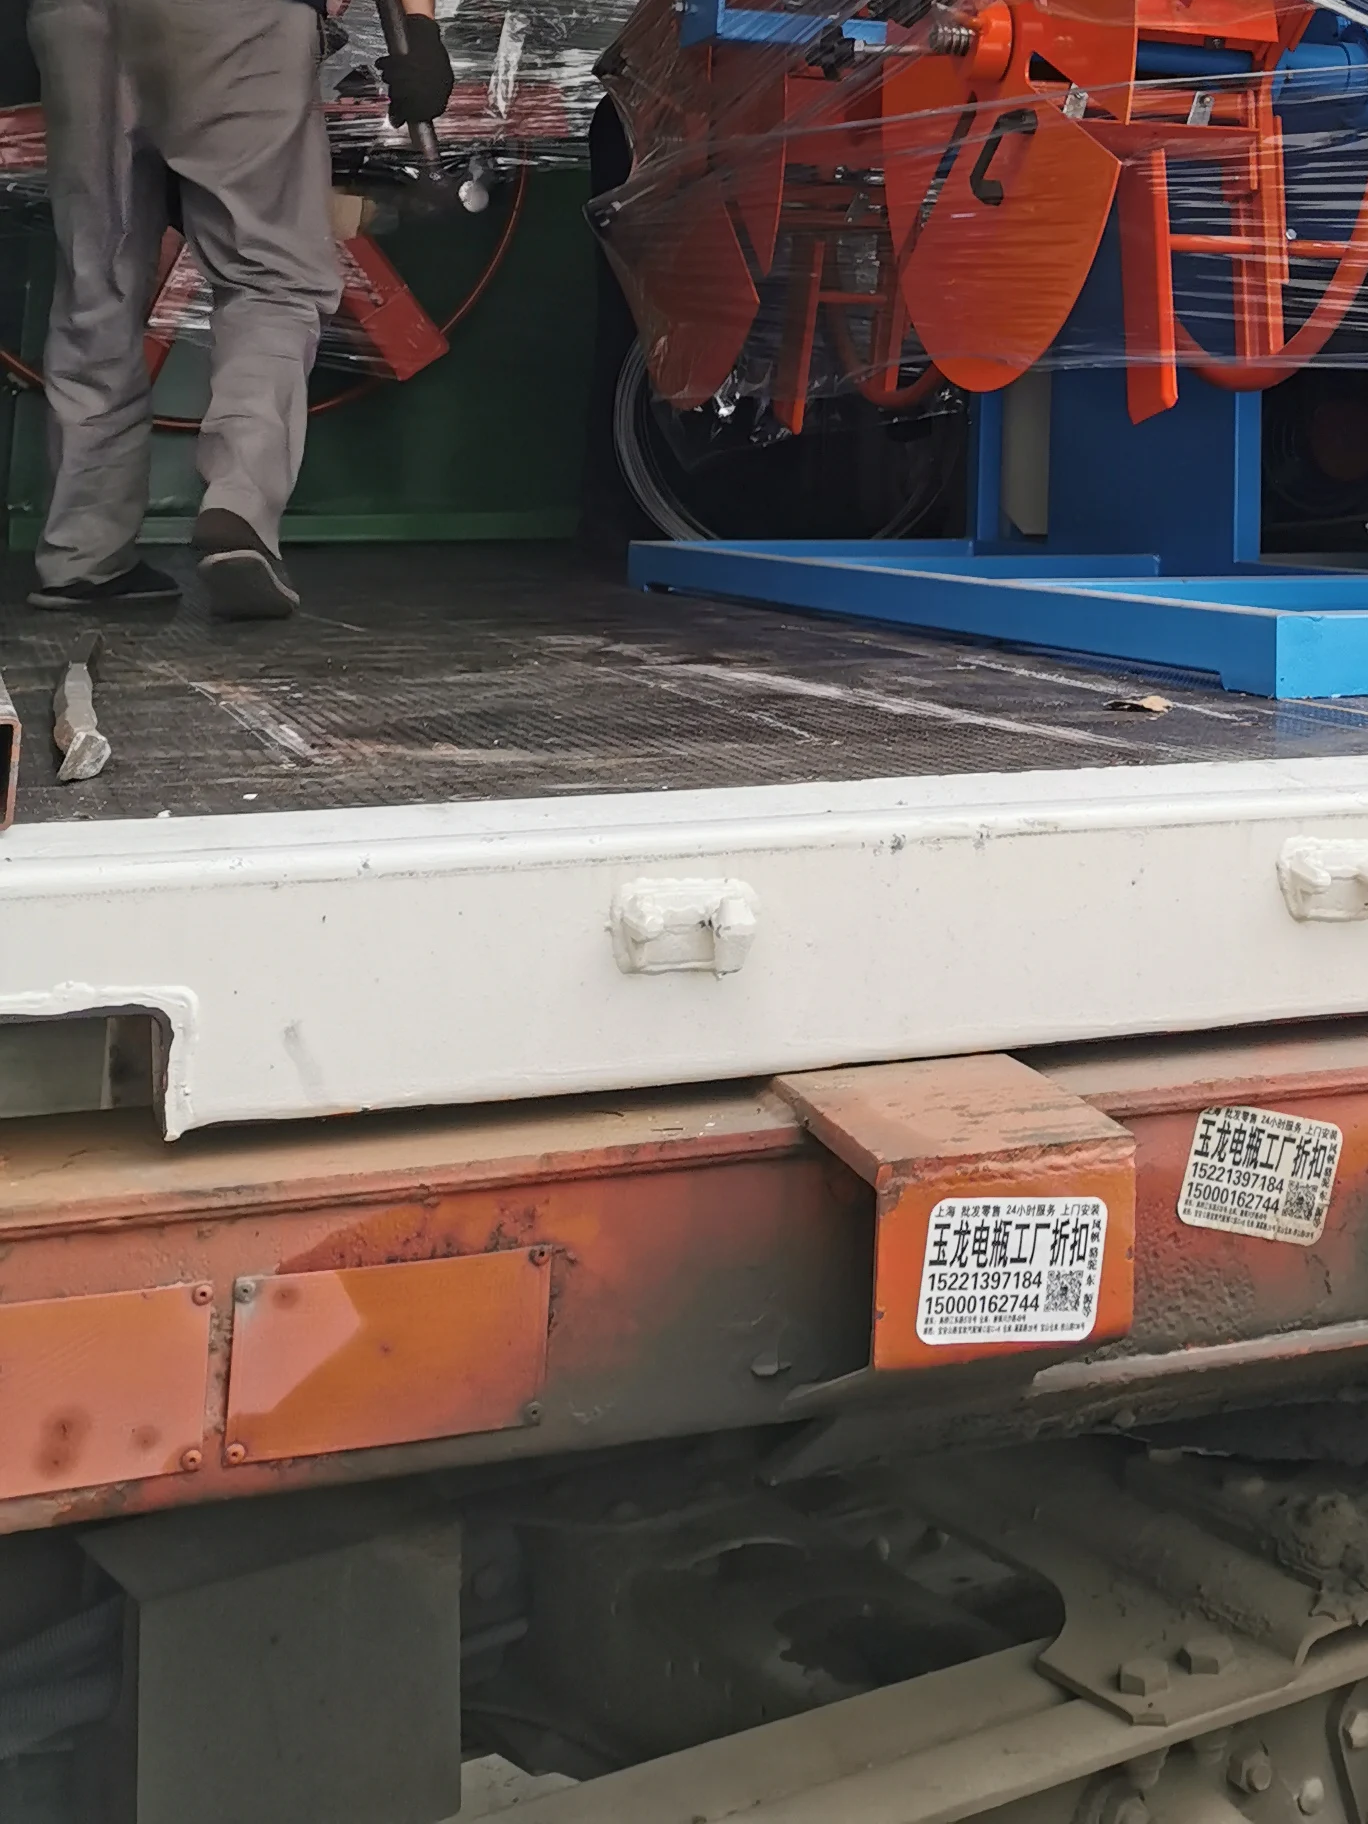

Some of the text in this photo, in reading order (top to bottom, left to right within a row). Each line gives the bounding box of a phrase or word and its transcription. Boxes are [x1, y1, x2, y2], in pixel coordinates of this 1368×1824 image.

[1260, 1115, 1302, 1133] 24小时服务
[1305, 1124, 1338, 1140] 上门安装
[1193, 1118, 1328, 1181] 玉龙电瓶工厂折扣
[1191, 1161, 1285, 1195] 15221397184
[935, 1203, 1100, 1218] 上海 批发零售 24小时服务 上门安装
[1187, 1181, 1280, 1215] 15000162744
[928, 1217, 1090, 1269] 玉龙电瓶工厂折扣
[927, 1270, 1043, 1292] 15221397184
[924, 1293, 1040, 1316] 15000162744
